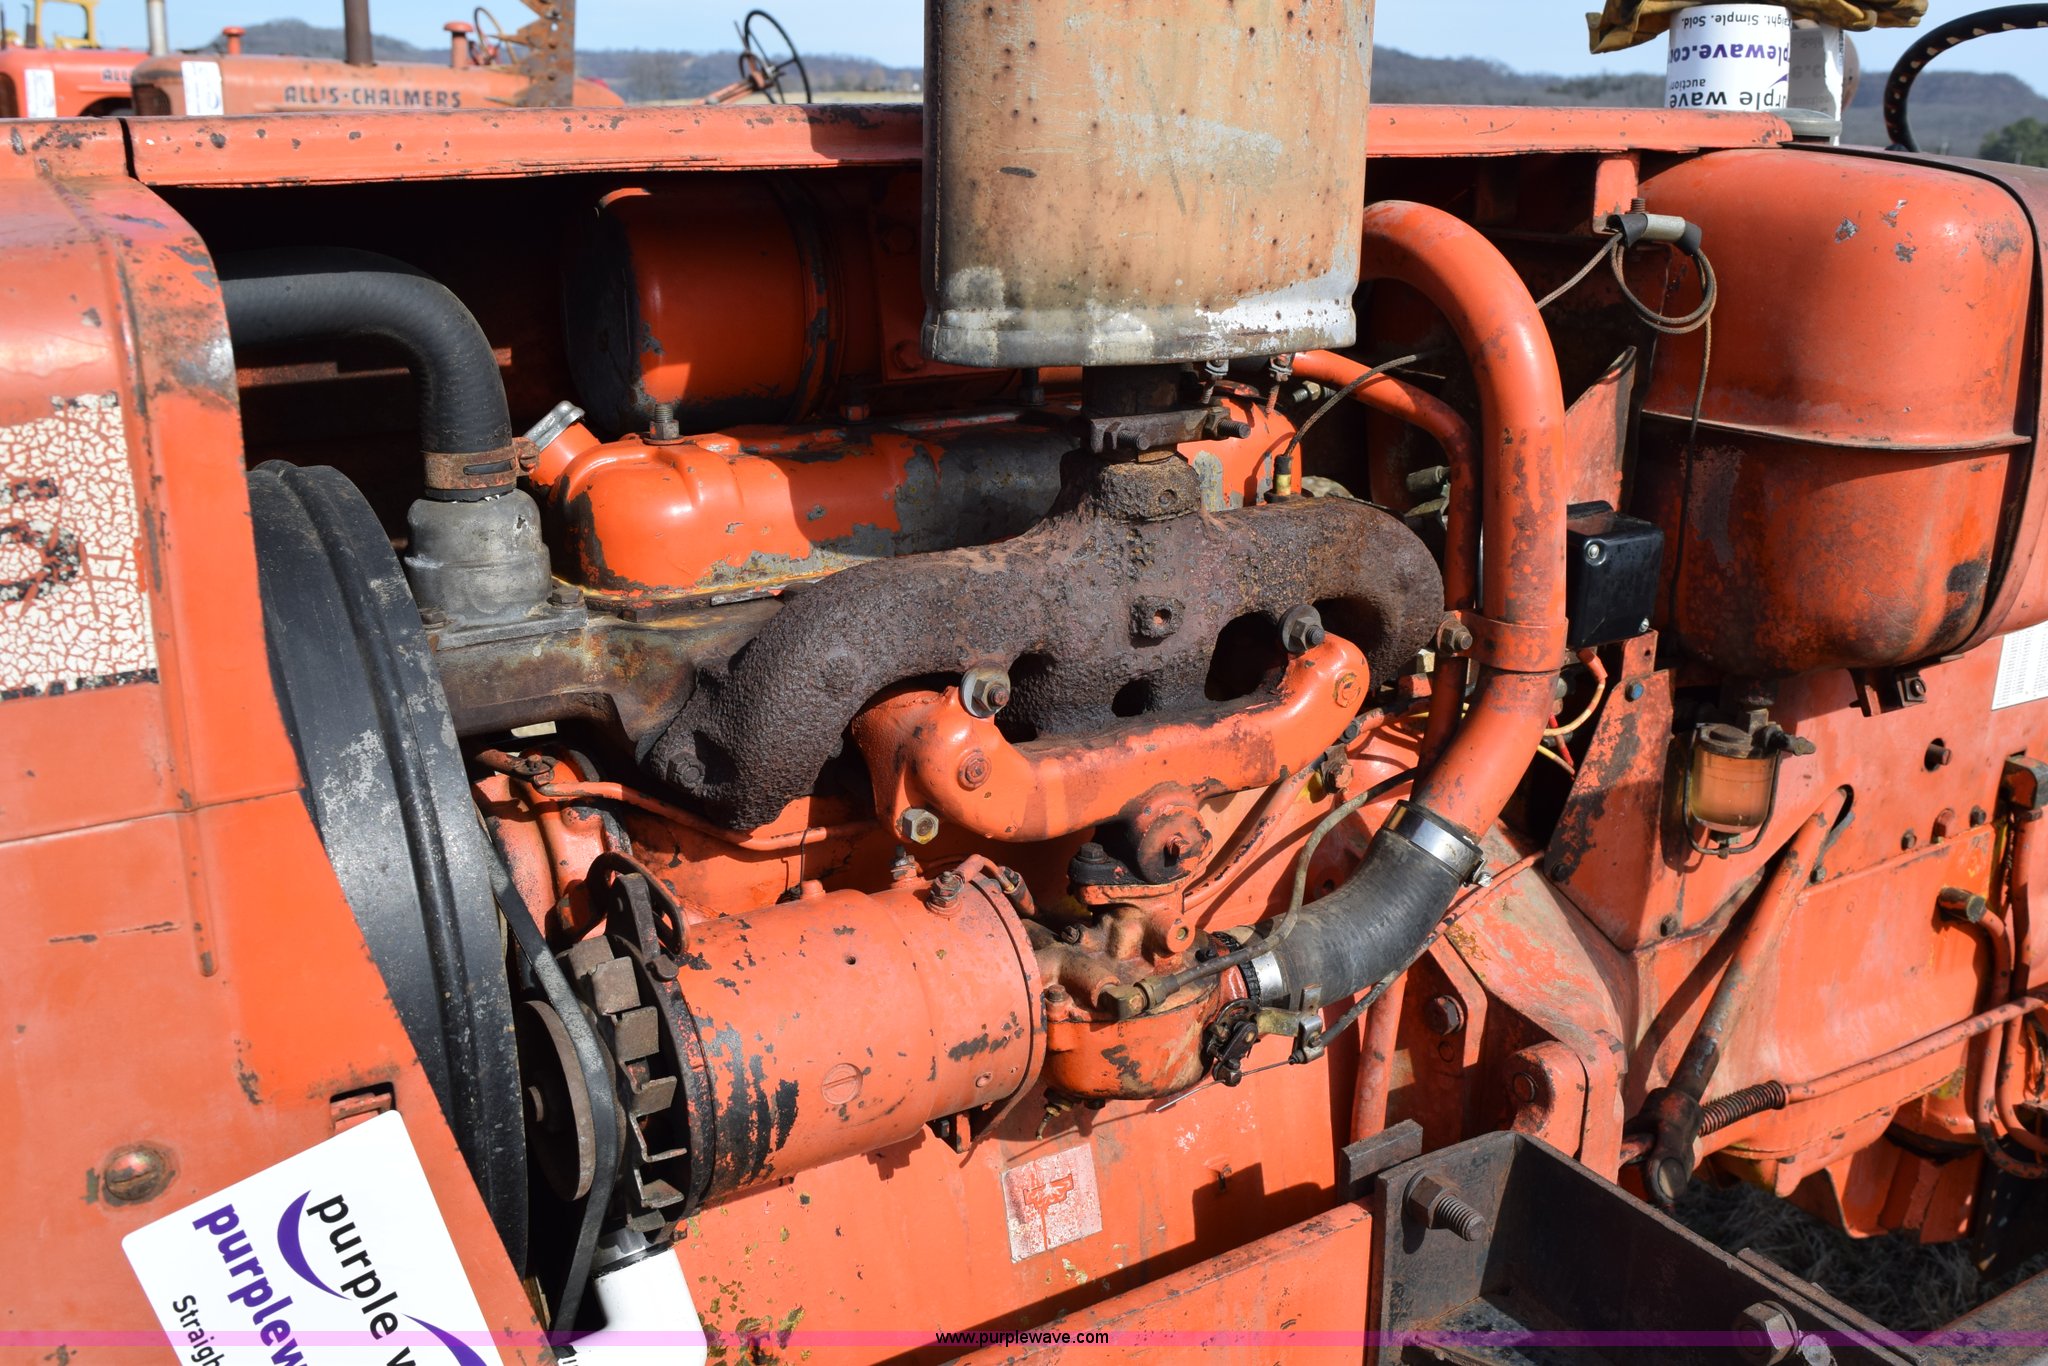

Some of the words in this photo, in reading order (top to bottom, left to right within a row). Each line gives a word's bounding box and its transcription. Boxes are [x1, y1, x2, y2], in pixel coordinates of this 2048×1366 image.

[1681, 15, 1707, 29] Sold.
[1711, 12, 1759, 27] Simple.
[1669, 91, 1728, 108] wave
[305, 1193, 400, 1341] purple
